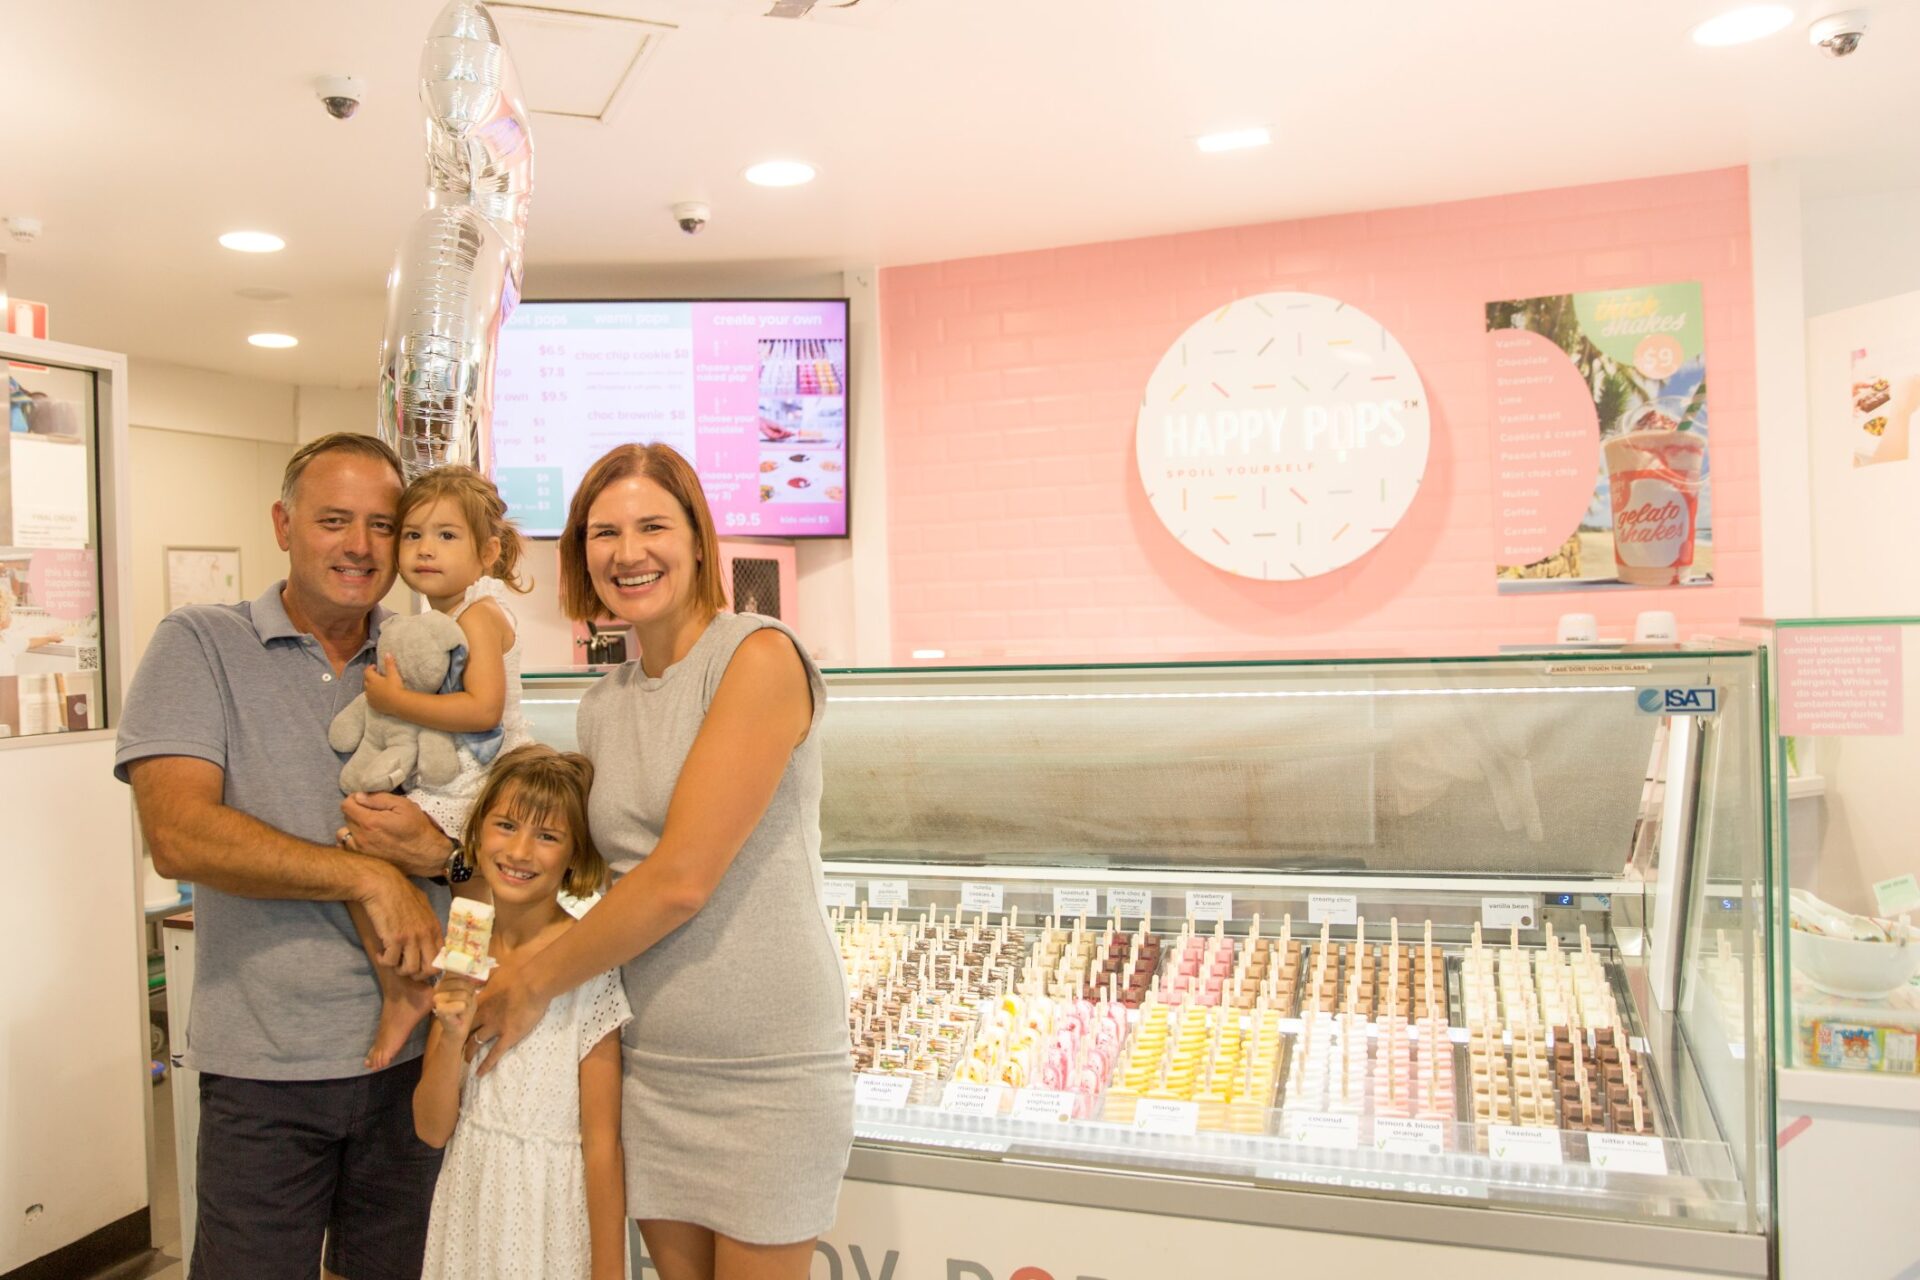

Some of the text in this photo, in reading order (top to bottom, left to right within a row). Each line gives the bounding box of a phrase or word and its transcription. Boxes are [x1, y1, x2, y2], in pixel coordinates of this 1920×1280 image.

[713, 314, 823, 328] create your own
[1496, 338, 1532, 348] Vanilla
[574, 349, 603, 361] choc
[605, 349, 630, 363] chip
[632, 349, 671, 360] cookie
[1496, 356, 1549, 367] Chocolate
[1643, 347, 1673, 370] $9
[1497, 375, 1554, 387] Strawberry
[587, 409, 615, 421] choc
[617, 408, 665, 421] brownie
[1499, 413, 1536, 424] Vanilla
[1163, 407, 1287, 457] HAPPY
[1302, 399, 1406, 458] POPS
[1166, 462, 1316, 479] SPOIL YOURSELF
[726, 512, 761, 527] $9.5
[1617, 500, 1680, 529] gelato
[1618, 523, 1684, 544] shakes
[1795, 634, 1864, 645] Unfortunately
[1784, 644, 1896, 656] cannot guarantee that
[1817, 656, 1862, 667] products
[1797, 666, 1881, 677] strictly free from
[1841, 678, 1871, 686] While
[1665, 689, 1701, 707] ISA
[1796, 689, 1810, 697] do
[1793, 700, 1867, 709] contamination
[1868, 700, 1878, 708] is
[1796, 710, 1884, 720] possibility during
[1192, 893, 1225, 901] strawberry
[1312, 896, 1335, 904] creamy
[954, 1099, 984, 1108] yoghurt
[1152, 1104, 1181, 1113] mango
[1308, 1115, 1342, 1124] coconut
[1377, 1119, 1404, 1128] lemon
[1414, 1121, 1440, 1131] blood
[854, 1129, 905, 1143] mium
[1392, 1129, 1424, 1138] orange
[1505, 1129, 1543, 1138] hazelnut
[1601, 1137, 1649, 1147] bitter choc
[1273, 1170, 1469, 1197] naked pop $6.50
